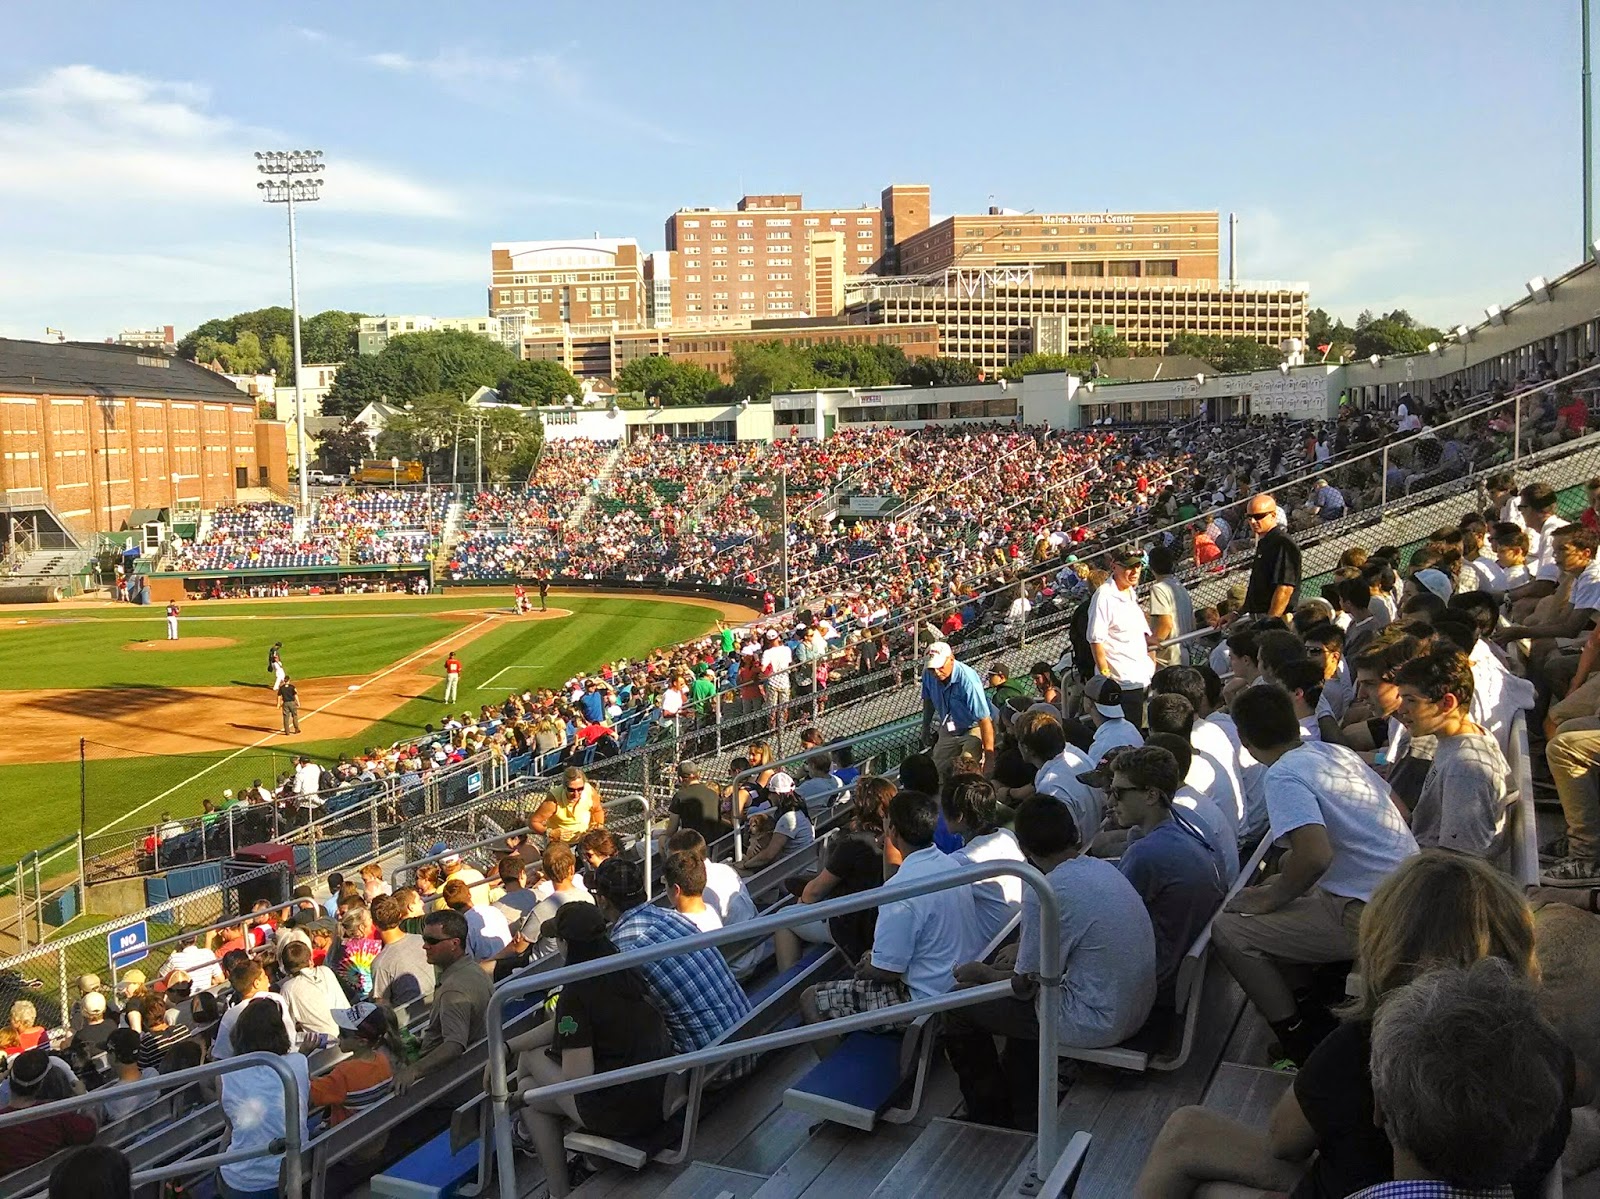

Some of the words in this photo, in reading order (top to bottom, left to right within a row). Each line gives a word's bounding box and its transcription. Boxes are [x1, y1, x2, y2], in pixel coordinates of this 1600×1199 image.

[1042, 215, 1069, 224] Maine
[1070, 215, 1104, 224] Medical
[1105, 214, 1135, 223] Center
[120, 933, 137, 949] NO
